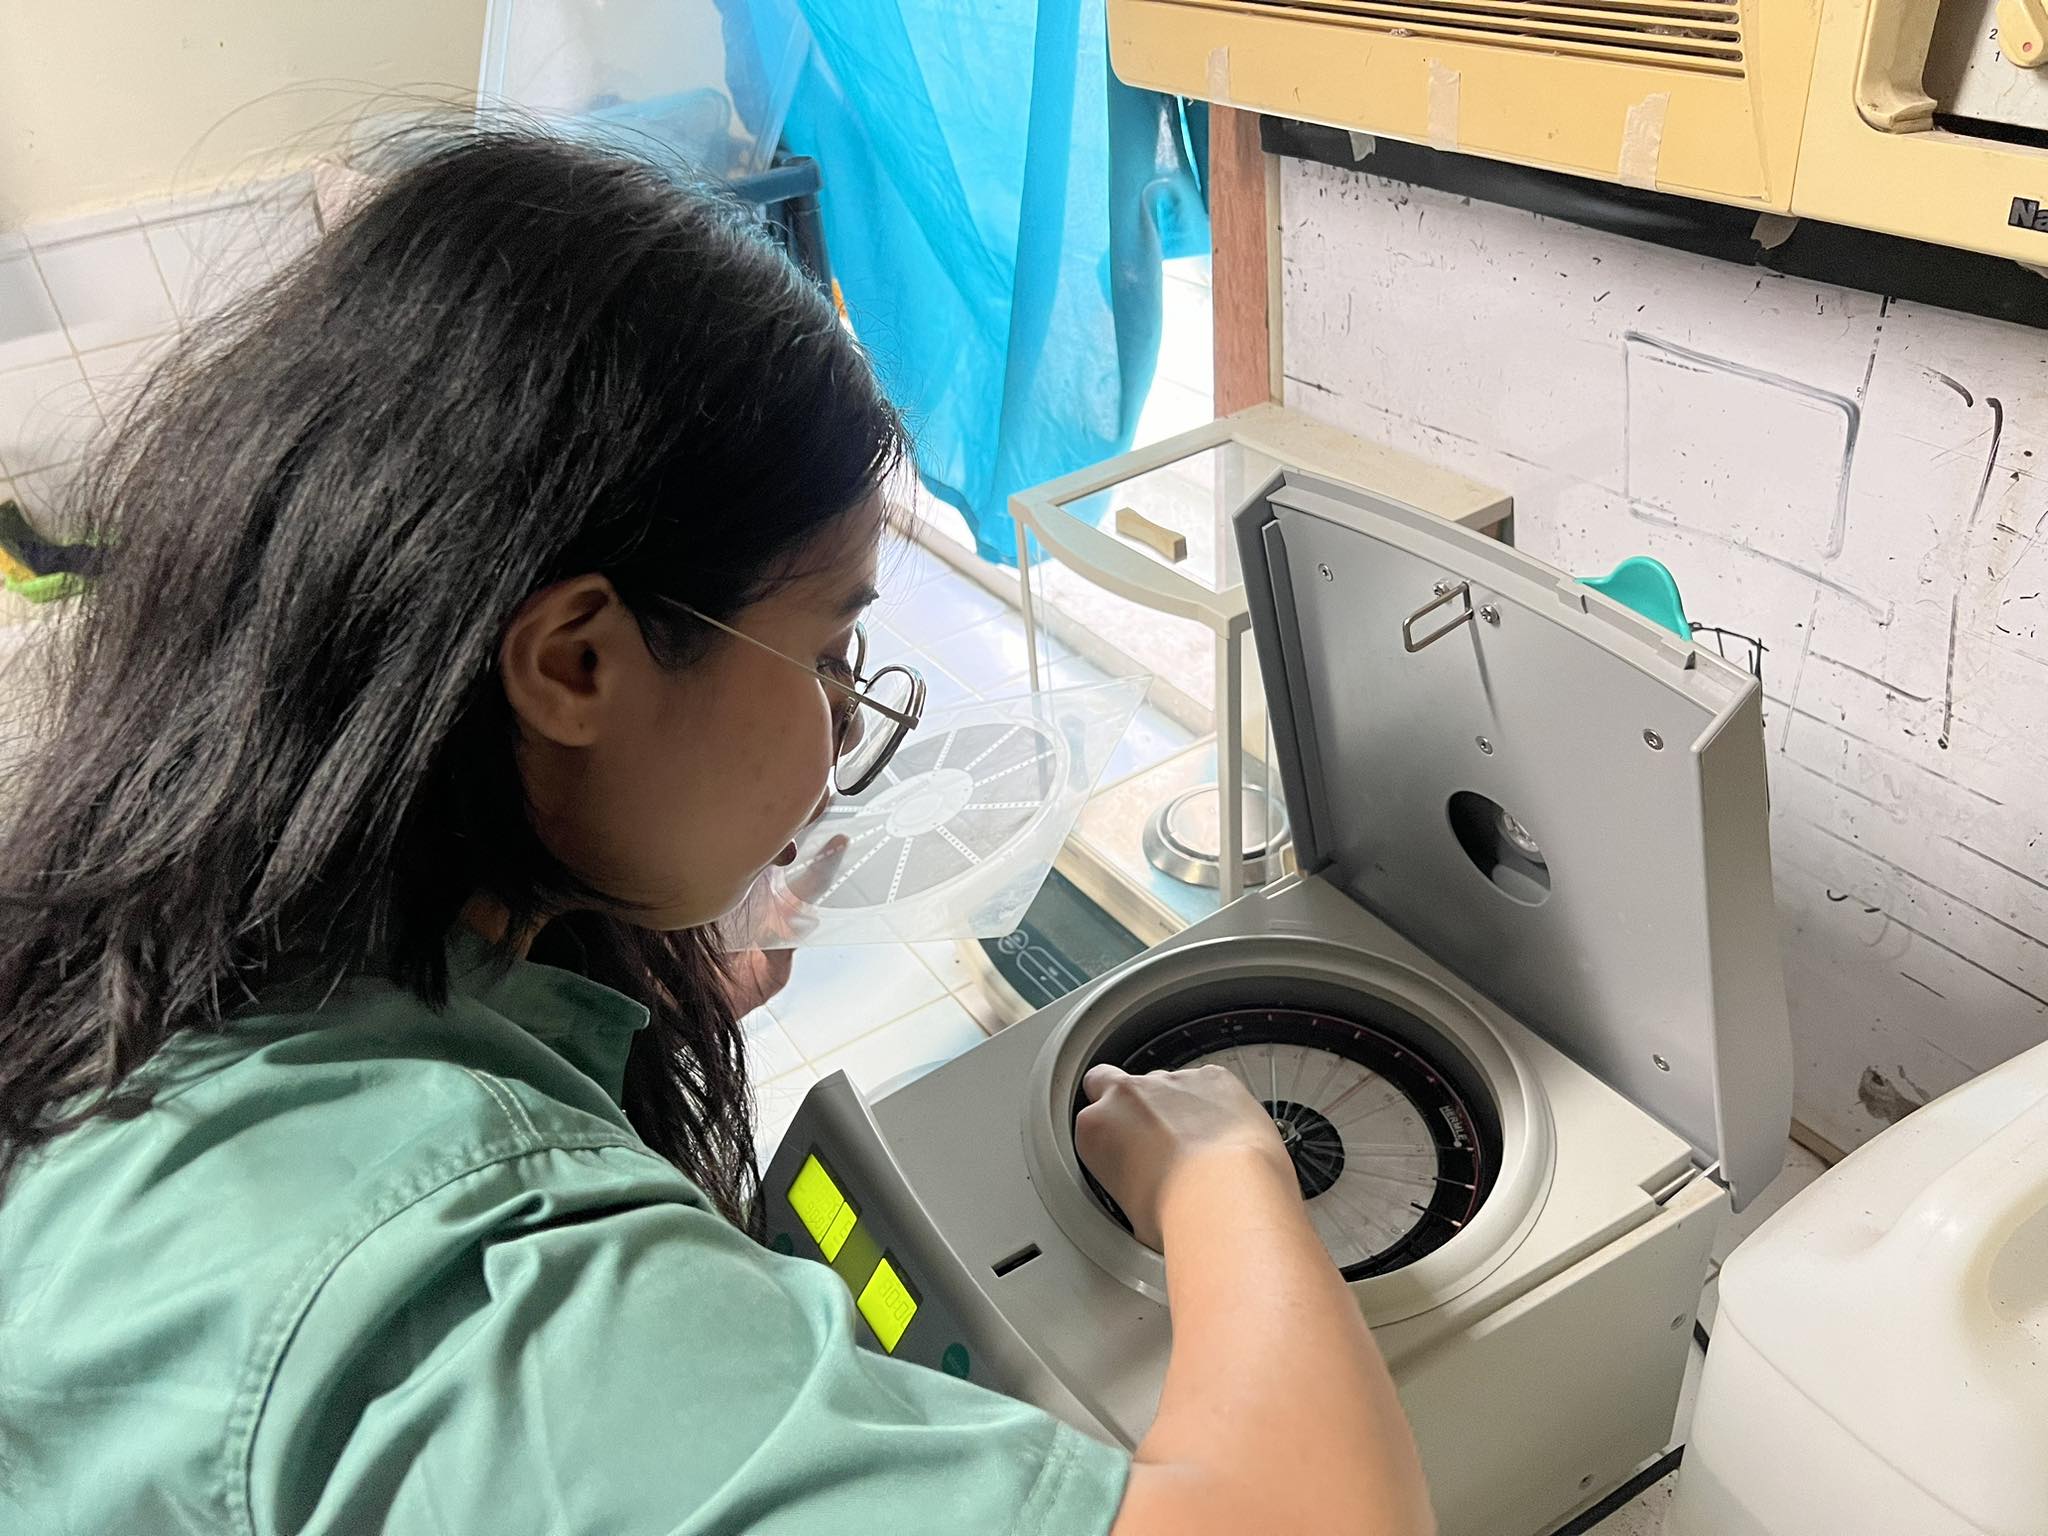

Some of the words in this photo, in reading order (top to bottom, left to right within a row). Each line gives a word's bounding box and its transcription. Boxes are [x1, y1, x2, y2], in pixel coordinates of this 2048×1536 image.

[1989, 28, 1999, 40] 2
[1995, 50, 2001, 62] 1
[1439, 1105, 1468, 1141] HERMLE
